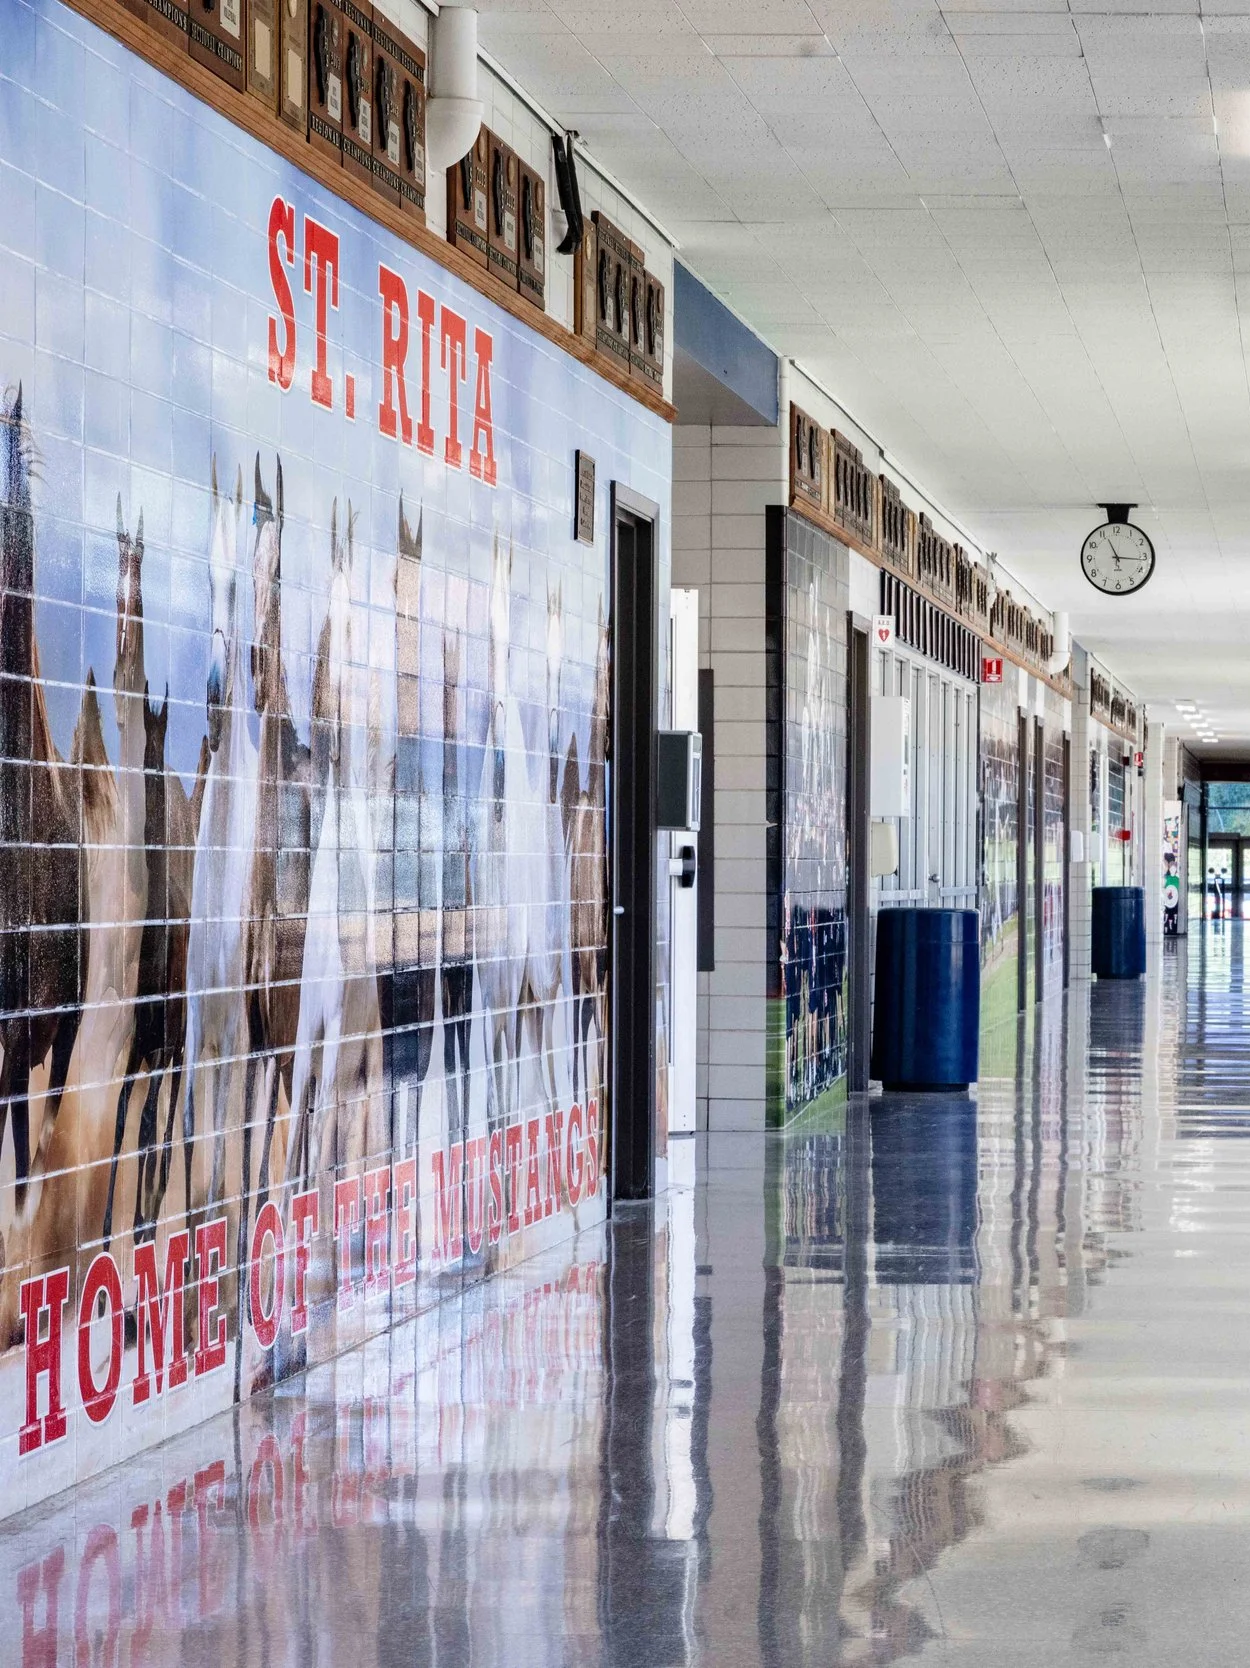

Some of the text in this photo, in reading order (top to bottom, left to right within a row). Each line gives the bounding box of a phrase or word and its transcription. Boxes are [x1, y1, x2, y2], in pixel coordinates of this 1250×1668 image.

[148, 0, 187, 31] AMPIONS
[345, 1, 370, 35] REGIONAL
[217, 41, 242, 71] CHAMPIONS
[374, 27, 398, 59] REGIONAL
[312, 116, 340, 149] REGIONAL
[343, 138, 371, 171] CHAMPIONS
[372, 159, 399, 191] CHAMPIONS
[267, 195, 498, 488] ST. RITA
[1089, 541, 1097, 549] 10
[1099, 530, 1105, 538] 11
[1112, 526, 1120, 534] 12
[1086, 554, 1092, 563] 9
[1143, 553, 1147, 561] 3
[1091, 569, 1096, 577] 8
[1115, 582, 1121, 590] 6
[18, 1098, 598, 1457] HOME OF THE MUSTANGS
